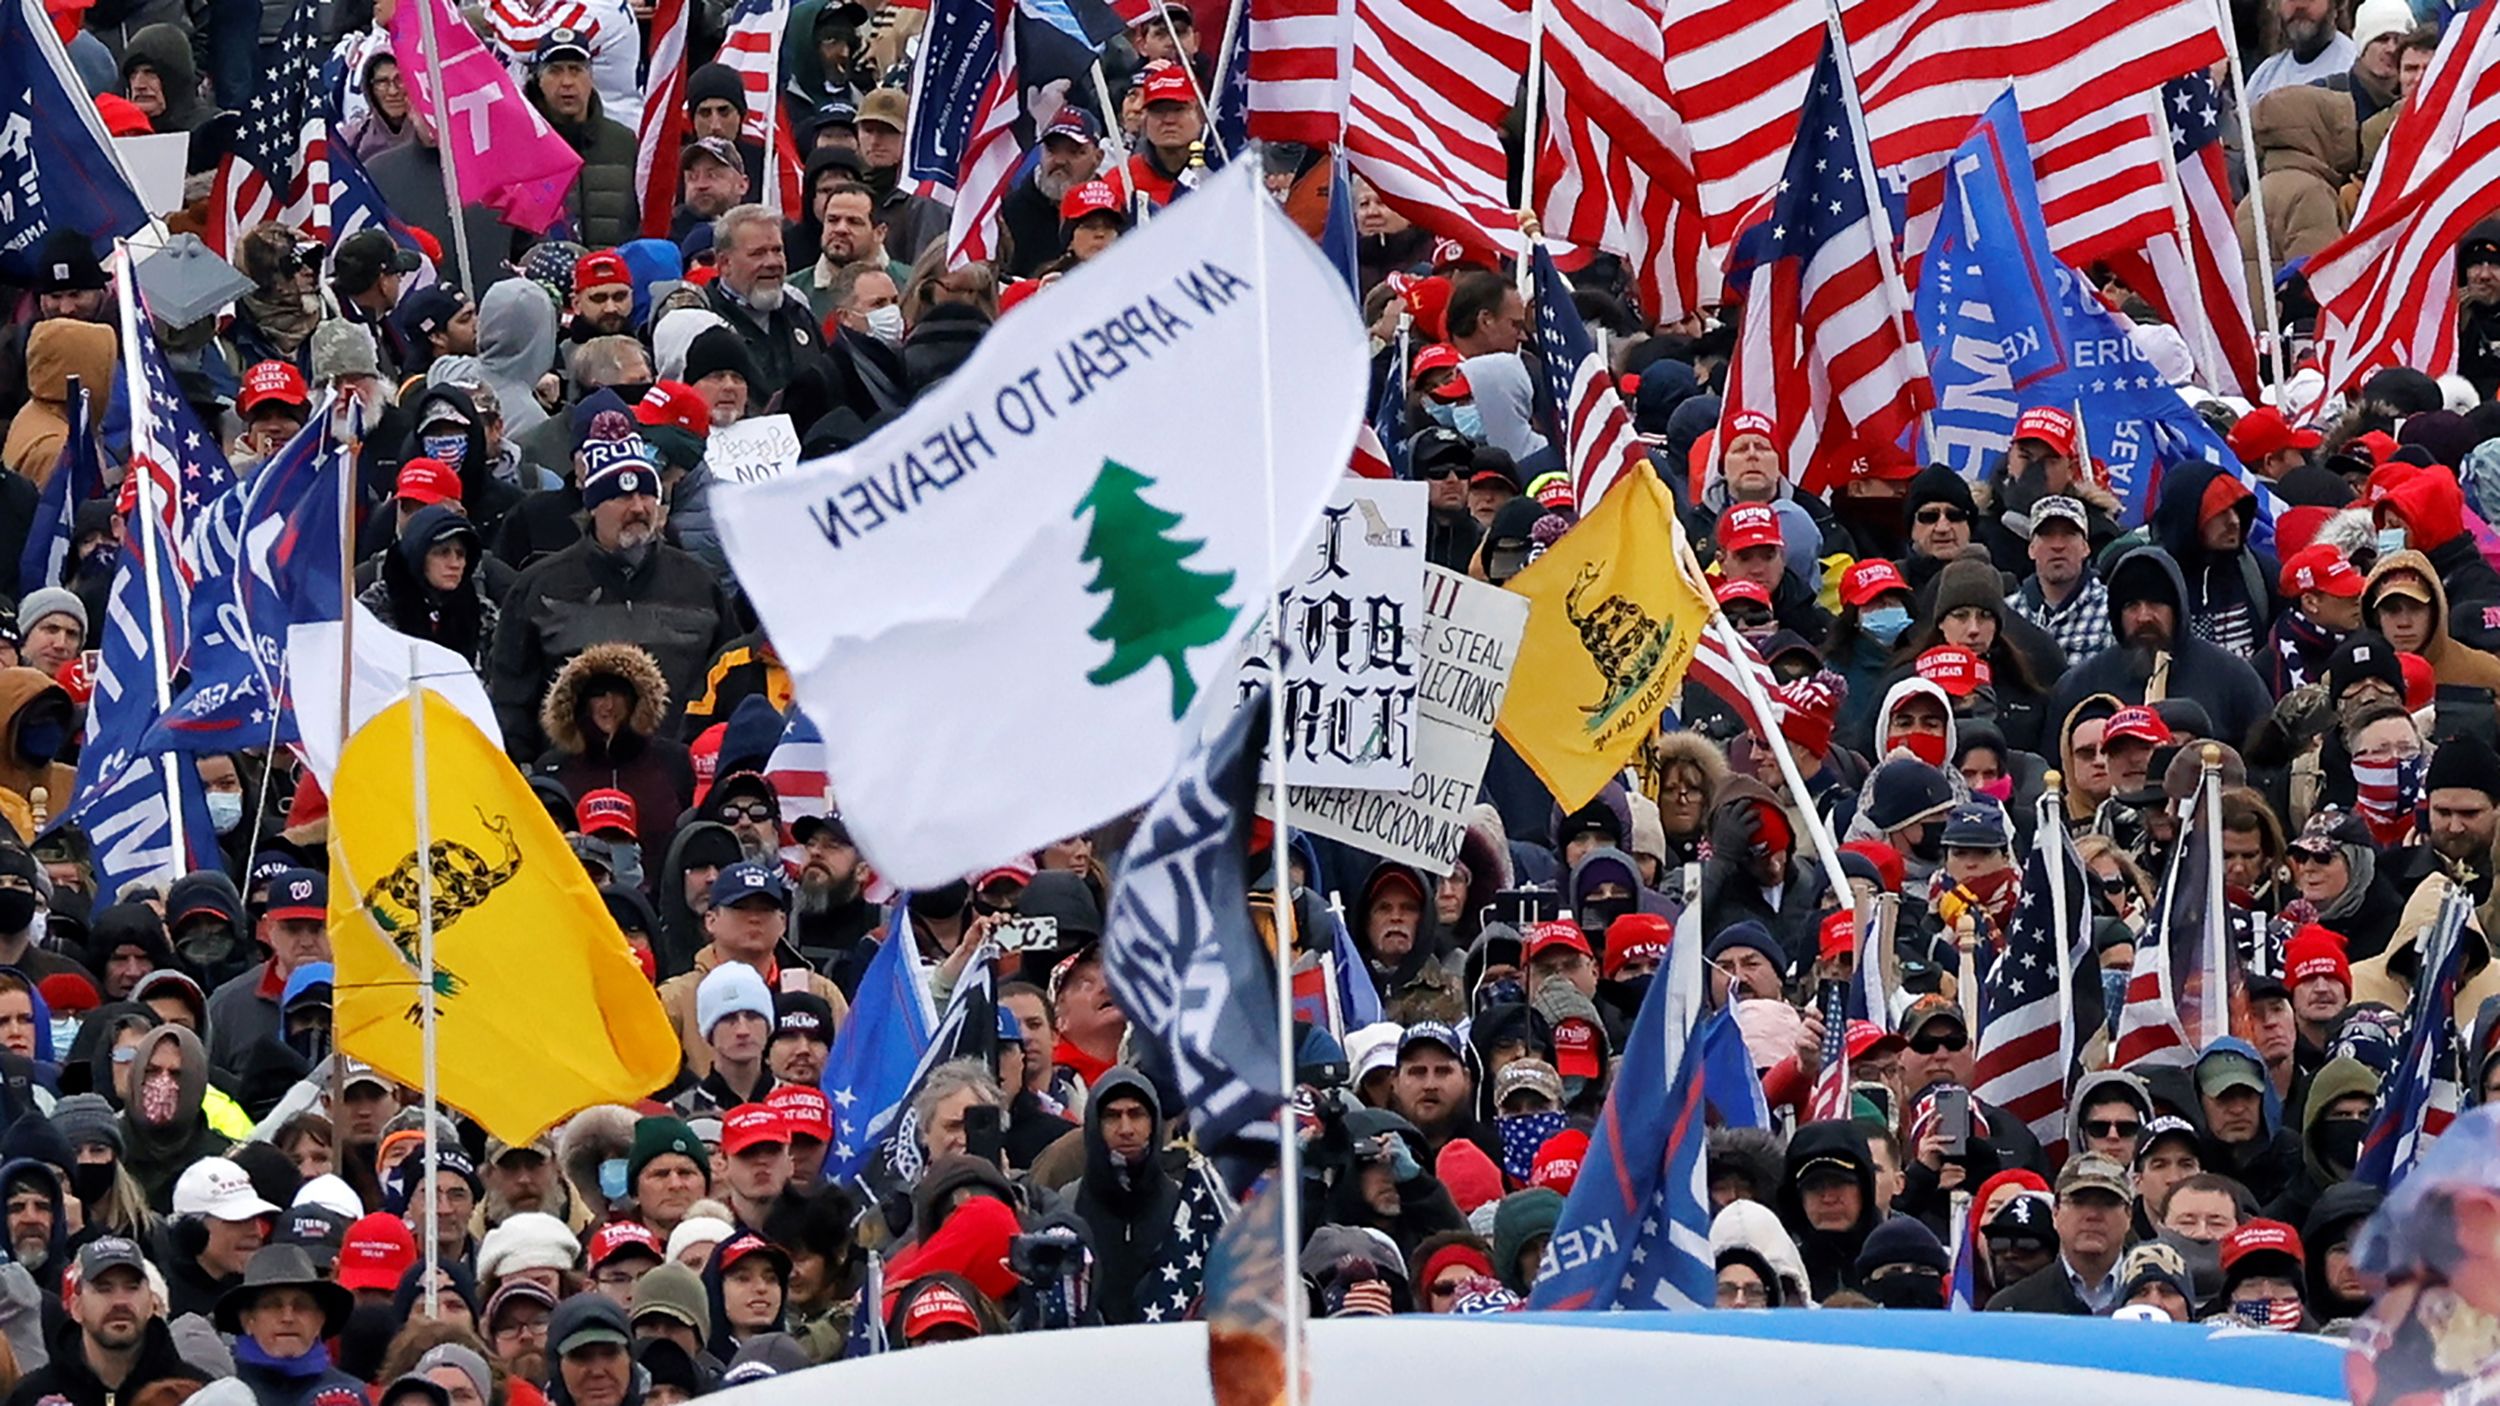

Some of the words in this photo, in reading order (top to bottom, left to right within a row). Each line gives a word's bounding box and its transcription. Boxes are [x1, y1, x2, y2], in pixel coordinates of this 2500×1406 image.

[250, 372, 292, 386] AMERICA
[254, 381, 286, 393] GREAT
[1730, 507, 1771, 527] TRUMP
[1306, 501, 1355, 585] I
[1438, 623, 1504, 671] STEAL
[1934, 652, 1968, 666] AMERICA
[1937, 666, 1963, 679] AGAIN
[1418, 654, 1505, 725] LECTIONS
[1397, 772, 1475, 815] OVET
[1351, 795, 1467, 865] LOCKDOWNS
[780, 1015, 820, 1029] TRUMP
[1405, 1020, 1453, 1037] TRUMP
[2144, 1114, 2196, 1133] TRUMP
